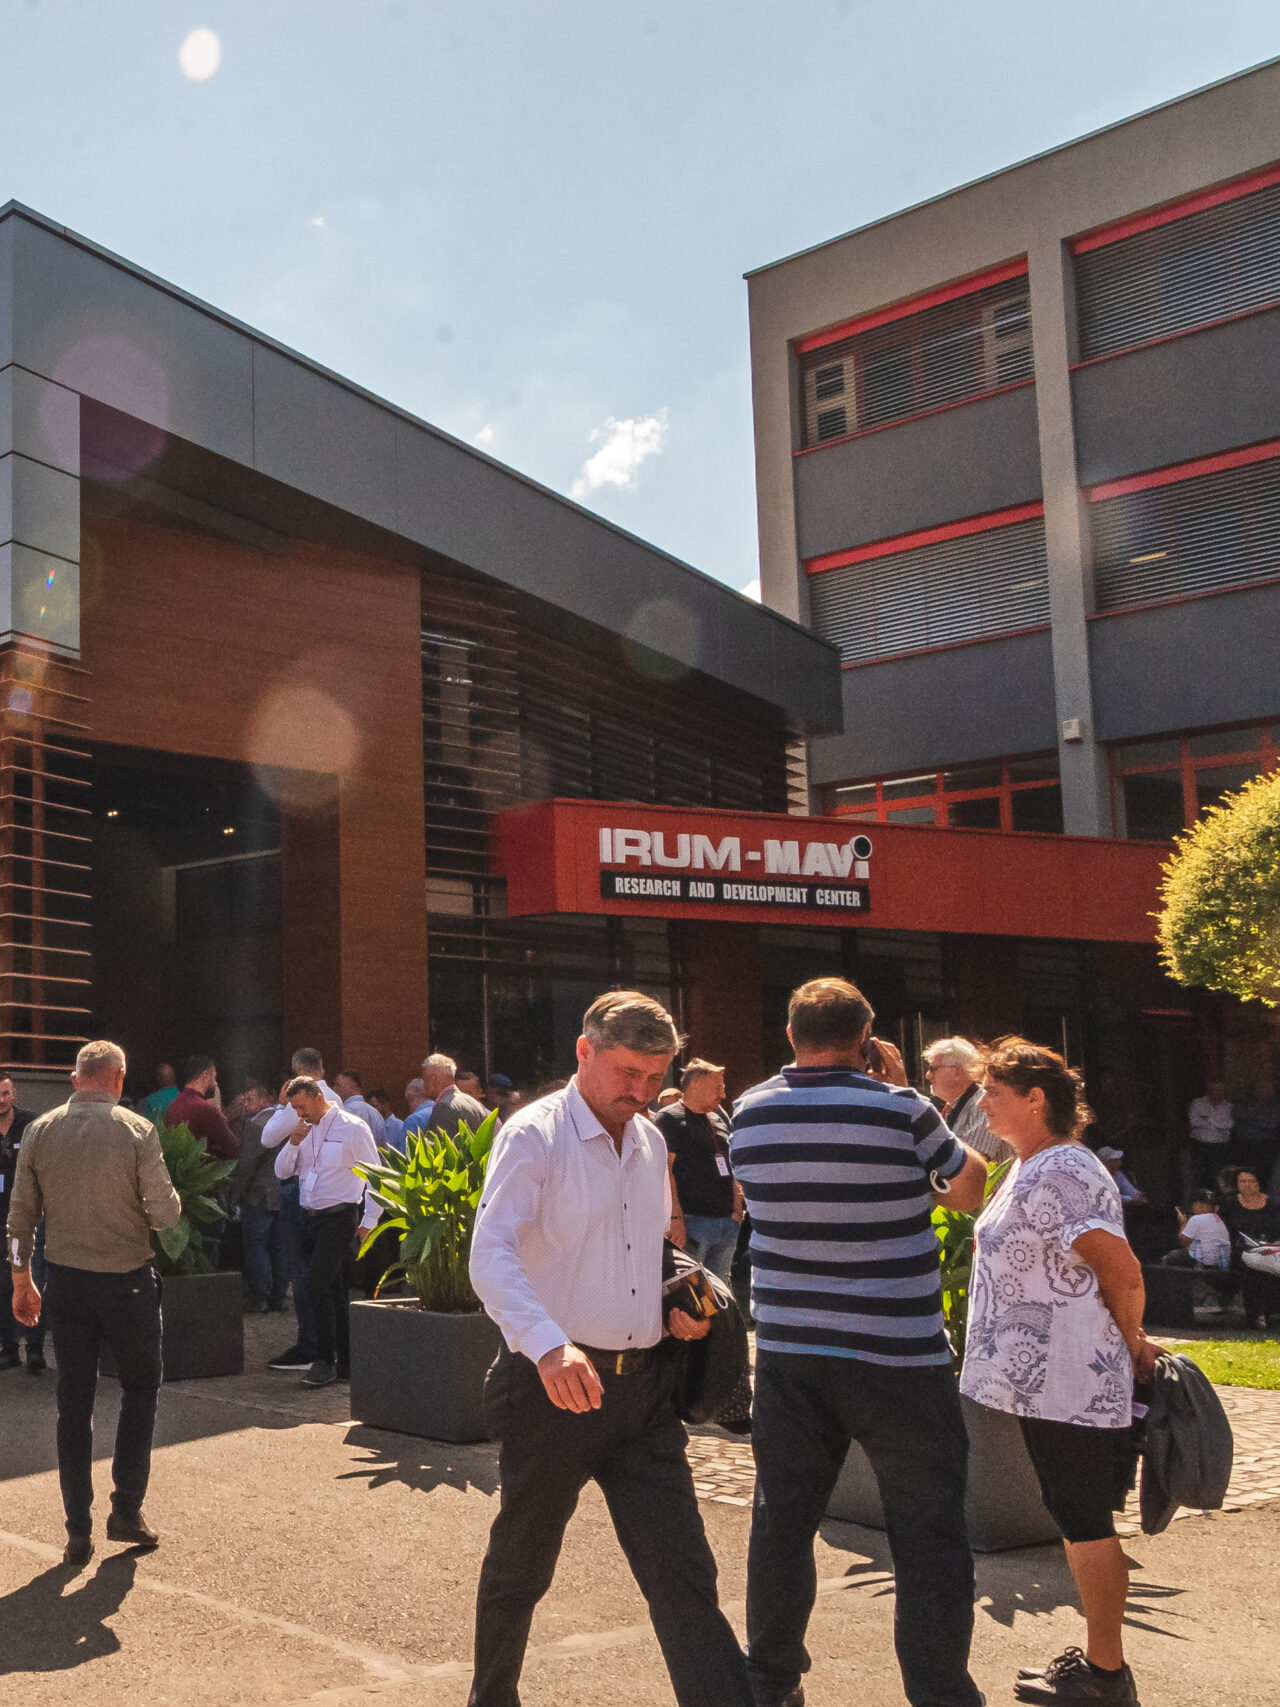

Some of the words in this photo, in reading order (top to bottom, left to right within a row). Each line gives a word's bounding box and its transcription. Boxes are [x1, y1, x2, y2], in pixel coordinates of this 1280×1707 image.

[615, 876, 681, 896] RESEARCH
[689, 881, 715, 898] AND
[723, 883, 808, 904] DEVELOPMENT
[815, 888, 861, 907] CENTER
